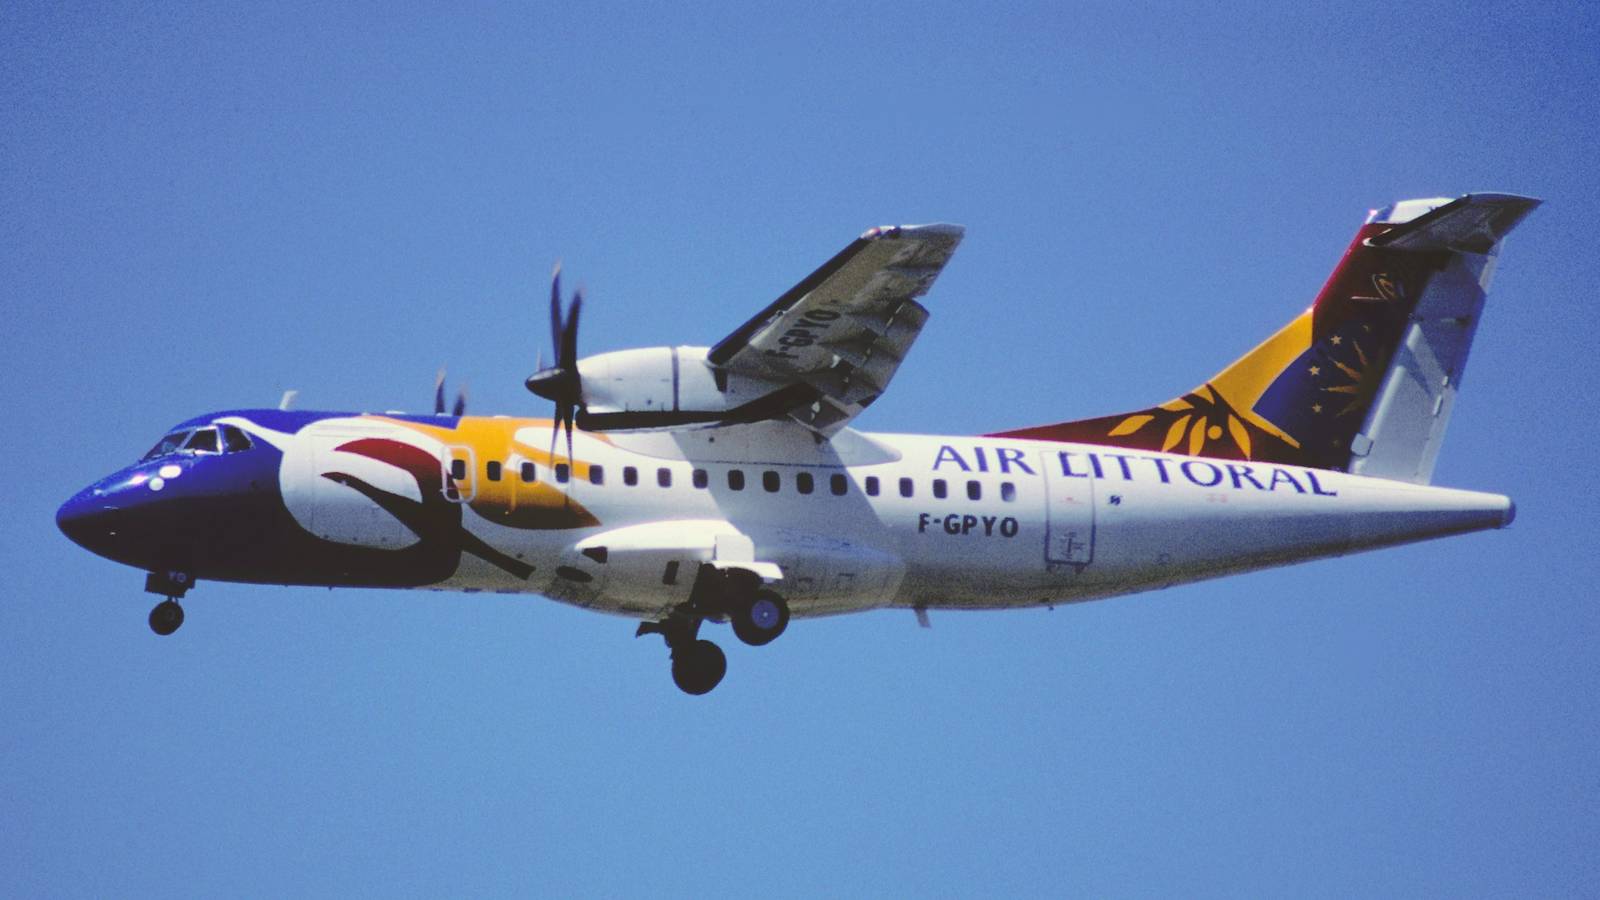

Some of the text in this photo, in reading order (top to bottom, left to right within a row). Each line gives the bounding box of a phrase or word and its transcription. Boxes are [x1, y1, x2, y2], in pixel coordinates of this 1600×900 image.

[765, 311, 840, 359] F-GPYO
[933, 445, 1338, 497] AIR LITTORAL
[918, 513, 1018, 538] F-GPYO
